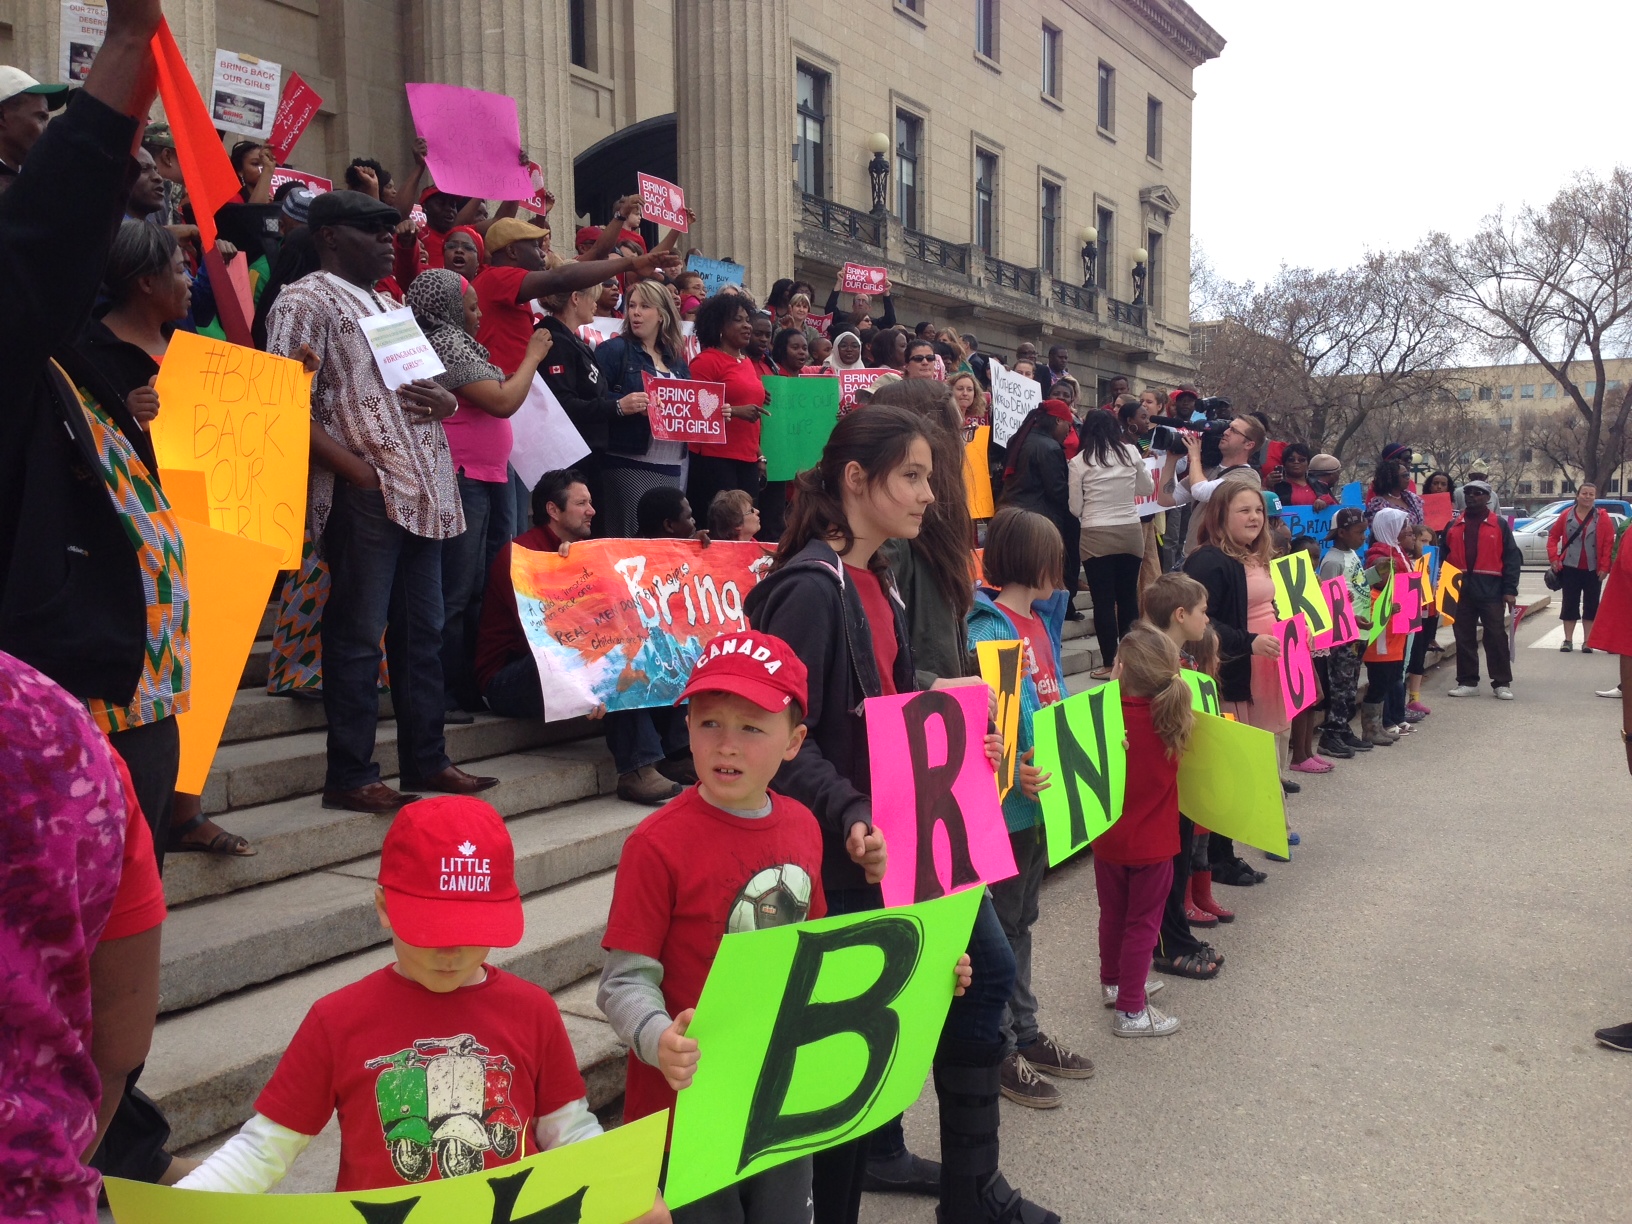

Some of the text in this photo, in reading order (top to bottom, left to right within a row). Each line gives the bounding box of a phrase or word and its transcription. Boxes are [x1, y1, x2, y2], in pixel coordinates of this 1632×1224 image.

[69, 4, 85, 13] OUR
[79, 15, 107, 27] DESERV
[220, 60, 275, 81] BRING BACK
[222, 73, 271, 91] OUR GIRLS
[642, 179, 668, 197] BRING
[644, 191, 665, 207] BACK
[644, 202, 684, 226] OUR GIRLS
[846, 266, 869, 276] BRING
[846, 273, 866, 282] BACK
[845, 281, 884, 292] OUR GIRLS
[844, 374, 879, 383] BRING
[657, 387, 695, 403] BRING
[194, 403, 285, 461] BACK
[663, 419, 720, 435] UR GIRLS
[210, 457, 268, 505] OUR
[1290, 515, 1332, 537] BRIN
[614, 555, 746, 633] Bring
[1276, 556, 1326, 633] K
[1329, 580, 1353, 644] R
[554, 626, 591, 646] REAL
[593, 604, 618, 626] MEN
[696, 638, 783, 675] CANADA
[1284, 620, 1305, 710] C
[1054, 686, 1112, 851] N
[902, 690, 981, 905] R
[441, 857, 491, 873] LITTLE
[439, 875, 491, 892] CANUCK
[736, 914, 924, 1175] B
